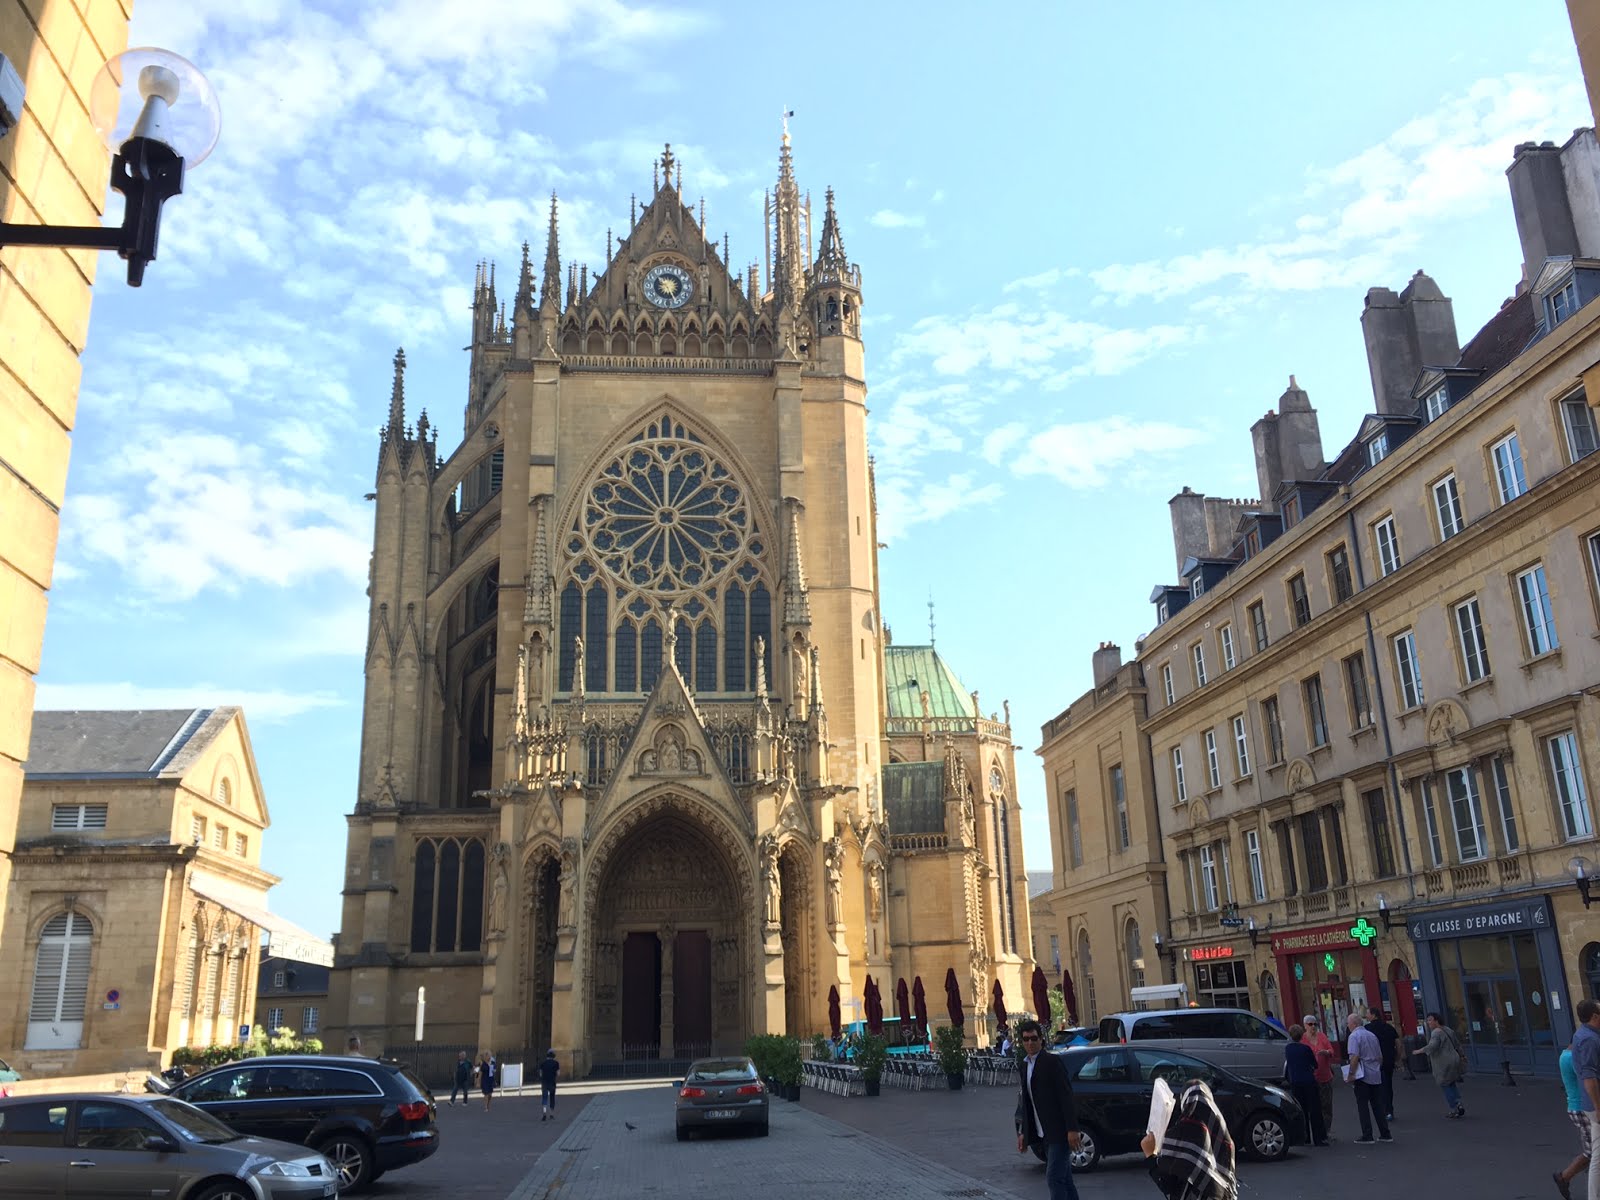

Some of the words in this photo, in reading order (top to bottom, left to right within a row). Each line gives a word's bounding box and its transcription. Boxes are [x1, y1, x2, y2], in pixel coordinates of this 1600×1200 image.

[1429, 920, 1461, 934] CAISSE
[1466, 911, 1523, 930] D'EPARGNE
[1282, 935, 1309, 949] PHARMACIE
[1309, 934, 1316, 947] DE
[1316, 932, 1324, 946] LA
[1323, 929, 1356, 945] CATHÉDRA
